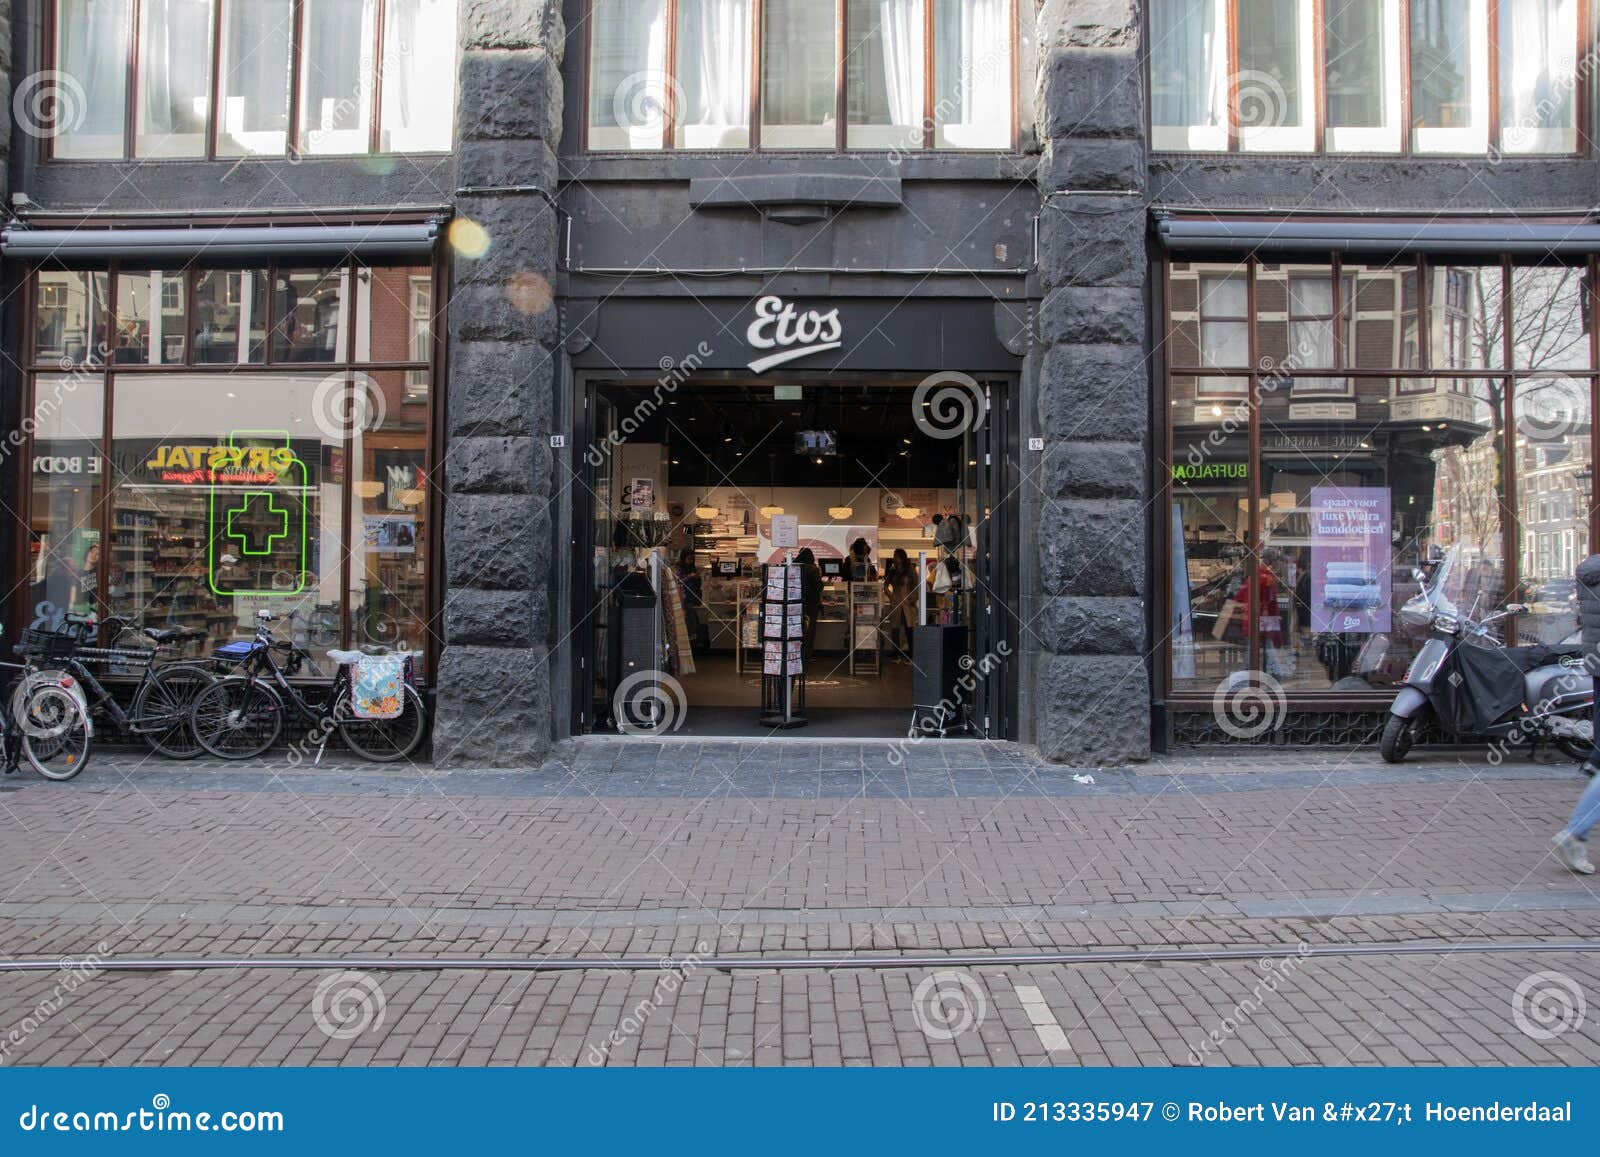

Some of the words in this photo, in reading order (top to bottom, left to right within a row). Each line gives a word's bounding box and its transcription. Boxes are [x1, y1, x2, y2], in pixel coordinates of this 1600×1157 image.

[747, 295, 842, 349] Etos
[1323, 499, 1351, 509] spaar
[1353, 499, 1379, 508] voor
[1322, 511, 1345, 521] luxe
[1318, 523, 1384, 535] handdoeken
